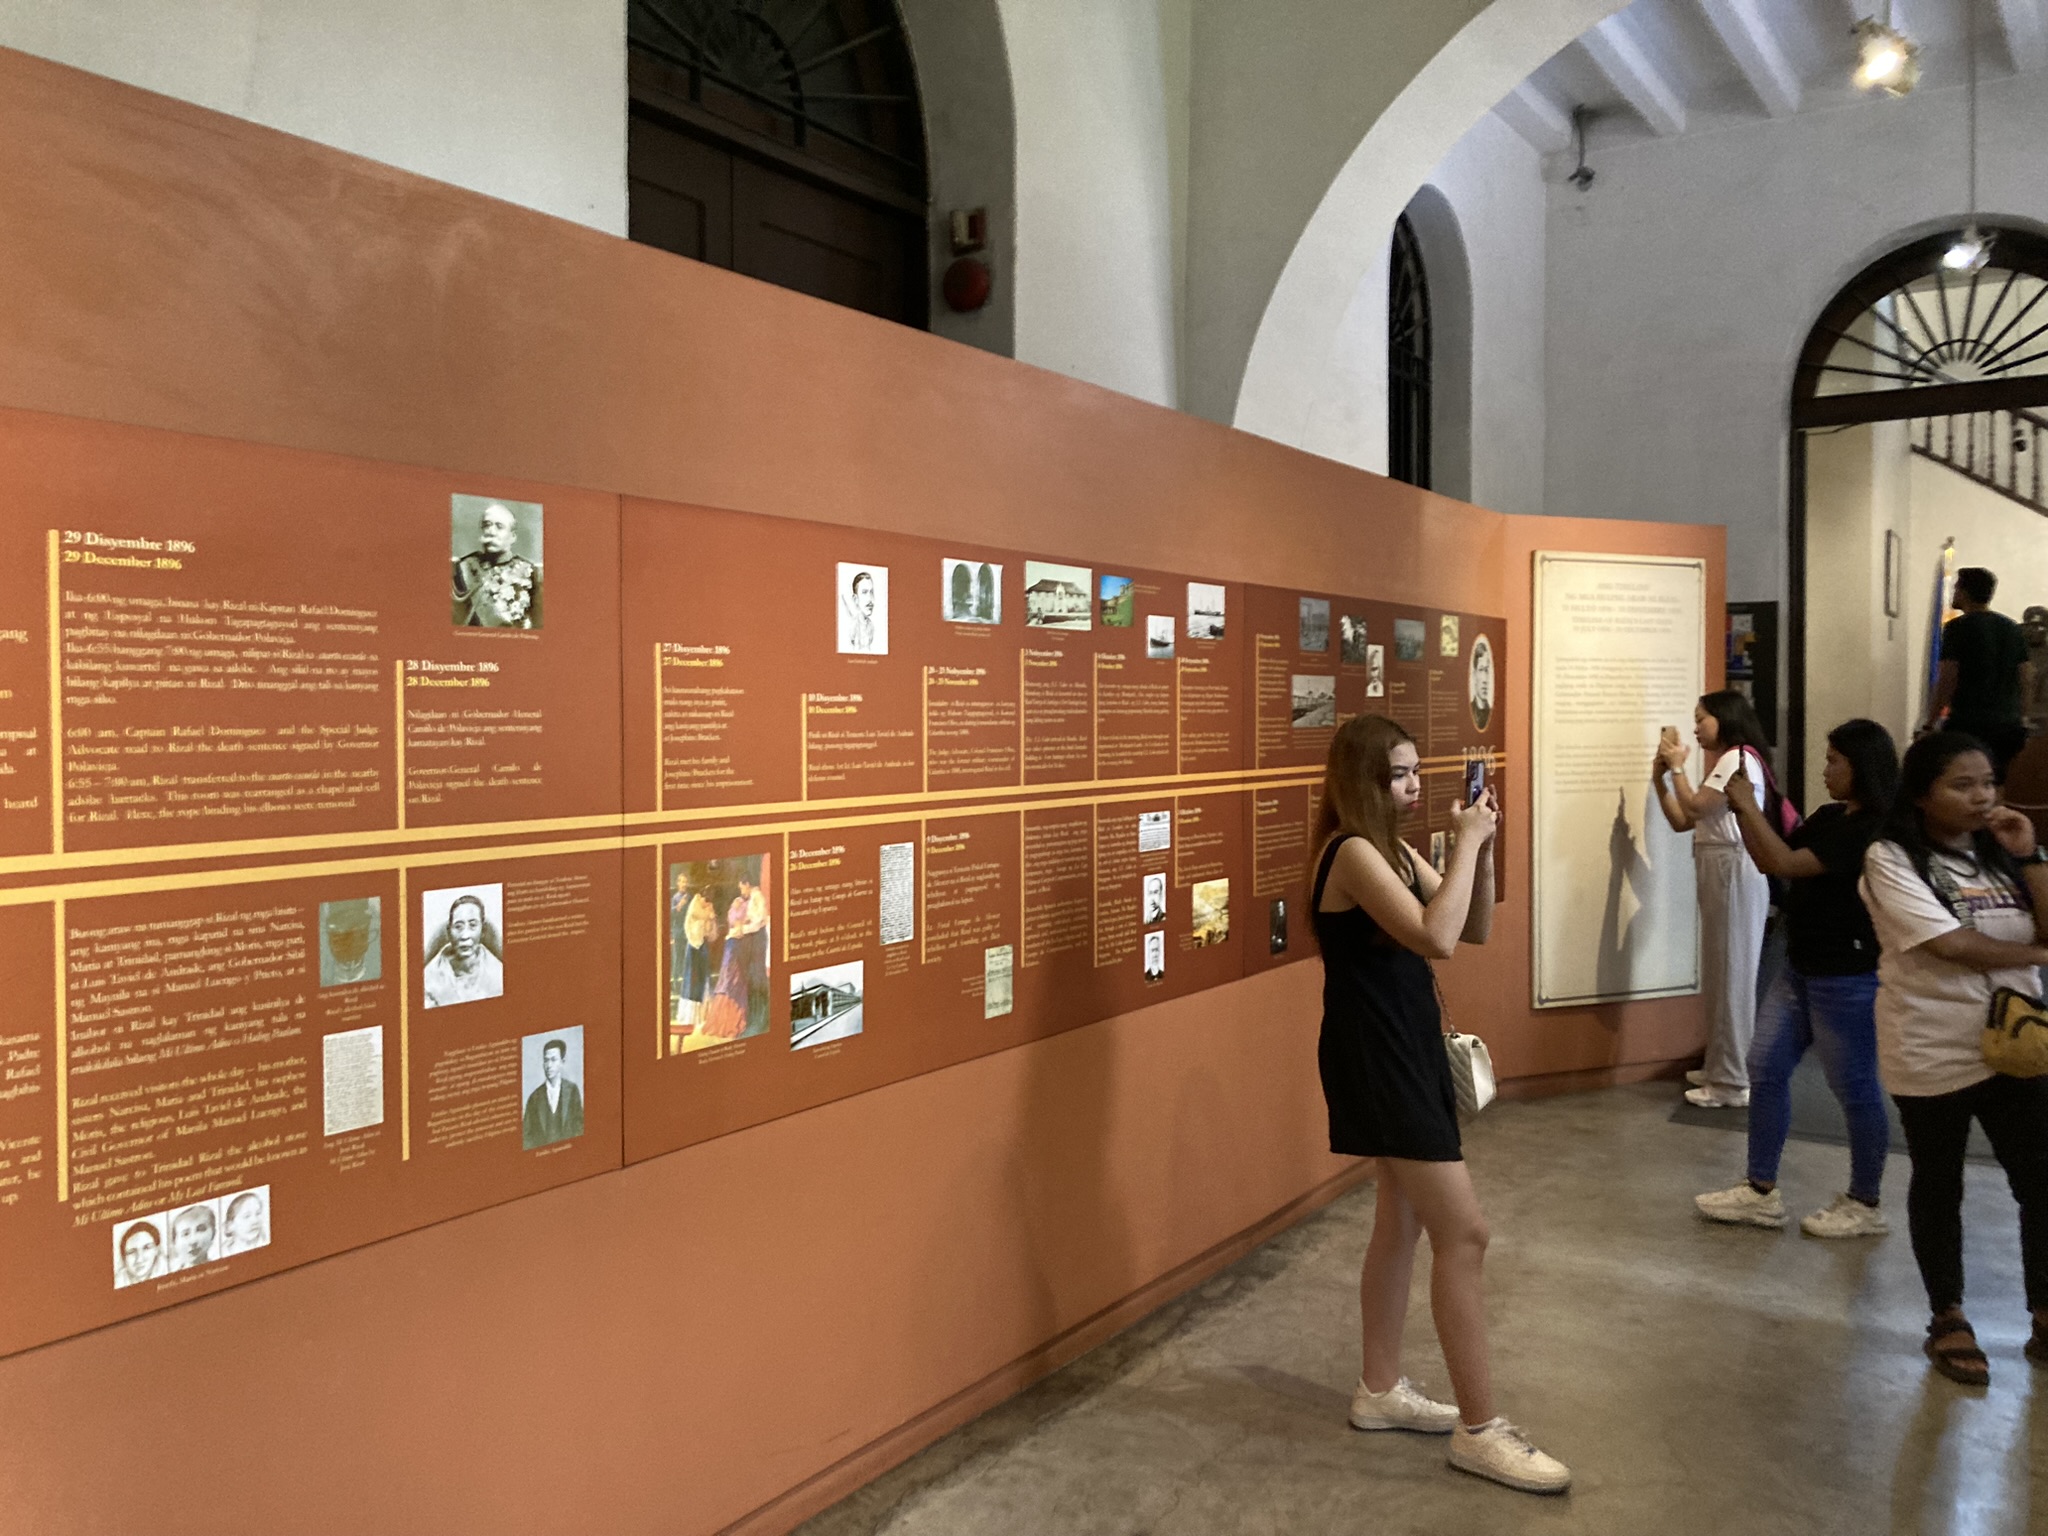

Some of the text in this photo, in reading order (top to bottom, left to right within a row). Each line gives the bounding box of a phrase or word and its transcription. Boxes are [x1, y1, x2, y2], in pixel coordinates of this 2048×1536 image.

[64, 530, 196, 553] 29 Disyembre 1896
[64, 550, 182, 570] 29 December 1896
[407, 660, 418, 670] 28
[479, 662, 499, 672] 1896
[406, 676, 490, 687] 28 December 1896
